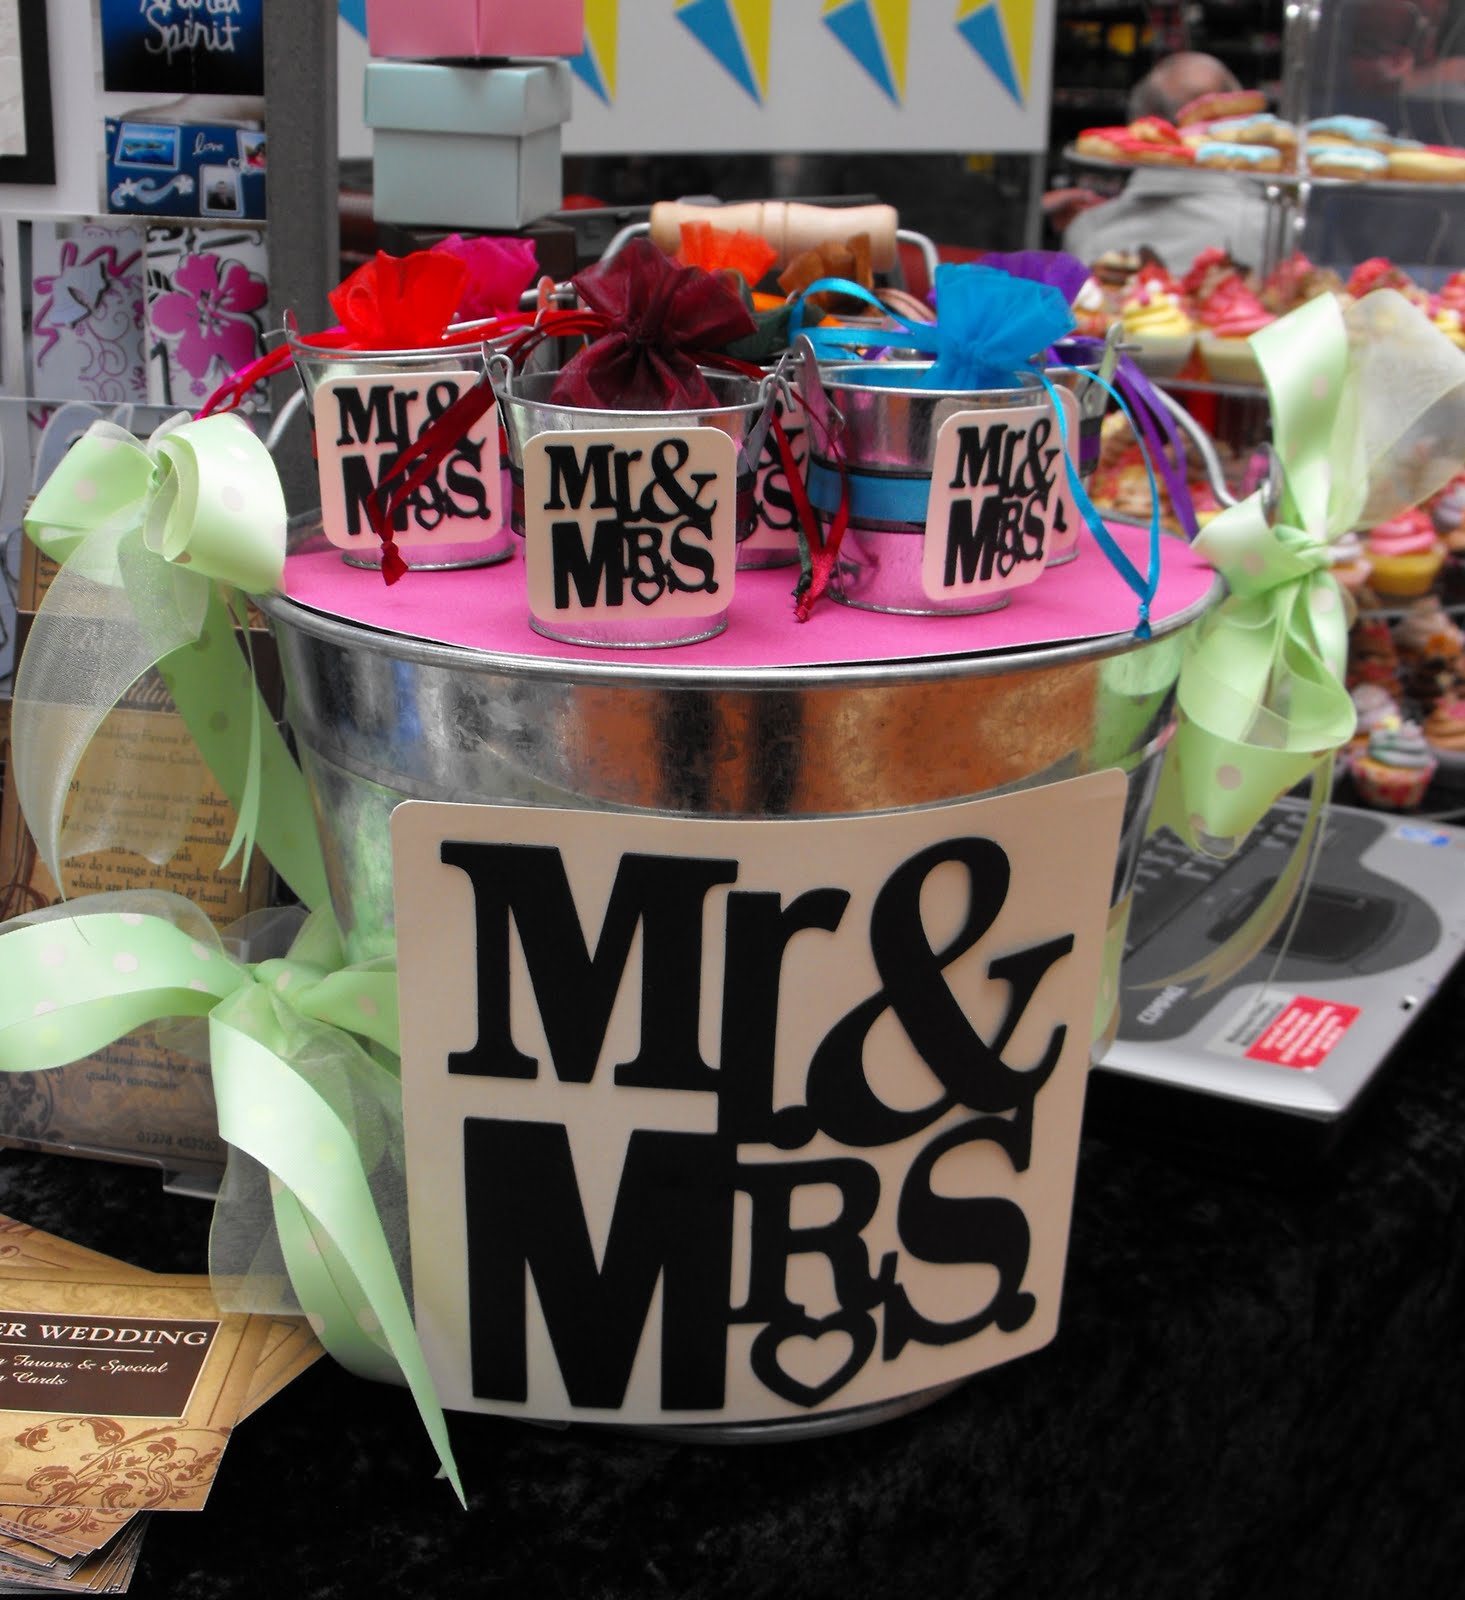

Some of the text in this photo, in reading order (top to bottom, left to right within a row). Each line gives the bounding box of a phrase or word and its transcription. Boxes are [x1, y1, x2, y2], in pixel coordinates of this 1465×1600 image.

[144, 4, 241, 66] Spirit
[89, 856, 103, 870] do
[116, 865, 146, 878] range
[150, 865, 162, 877] of
[165, 863, 210, 884] bespoke
[71, 873, 102, 890] which
[200, 886, 227, 904] hand
[39, 1324, 208, 1346] WEDDING
[13, 1354, 73, 1369] Favors
[77, 1359, 97, 1370] &
[101, 1359, 168, 1375] Special
[12, 1371, 69, 1385] Cards
